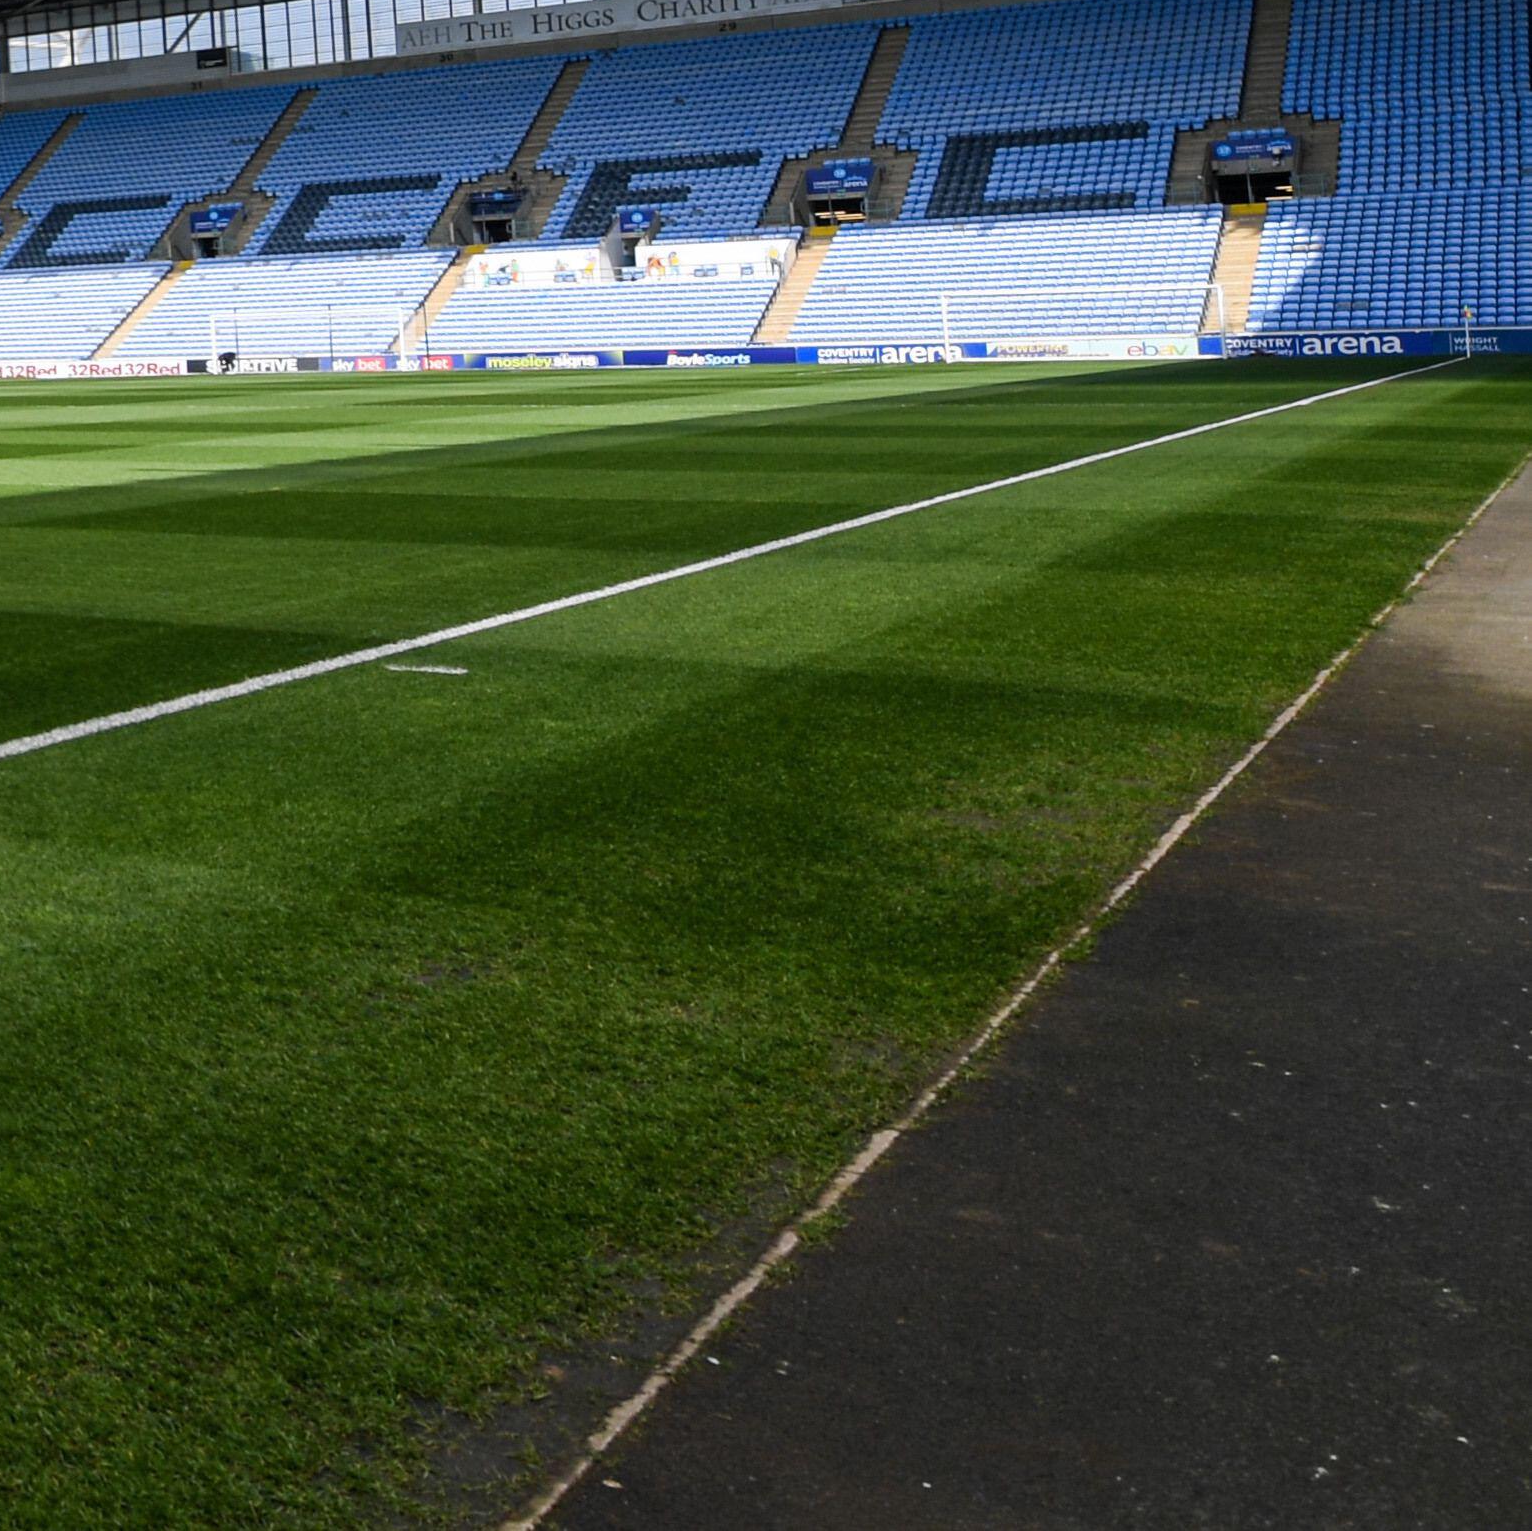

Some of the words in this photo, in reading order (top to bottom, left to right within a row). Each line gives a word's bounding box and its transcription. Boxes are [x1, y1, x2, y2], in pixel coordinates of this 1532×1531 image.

[402, 26, 451, 49] AEH
[460, 21, 513, 42] THE
[531, 9, 615, 34] HIGGS
[1225, 338, 1293, 348] COVENTRY
[1303, 336, 1403, 355] arena
[667, 352, 751, 366] BoyleSports
[818, 348, 874, 357] COVENTRY
[881, 345, 965, 364] arena
[333, 359, 354, 372] sky
[357, 358, 382, 370] bet
[423, 356, 449, 370] bet
[489, 354, 551, 368] moseley
[553, 354, 597, 368] signs
[5, 365, 57, 379] 32Red
[68, 364, 122, 378] 32Red
[125, 362, 181, 375] 32Red
